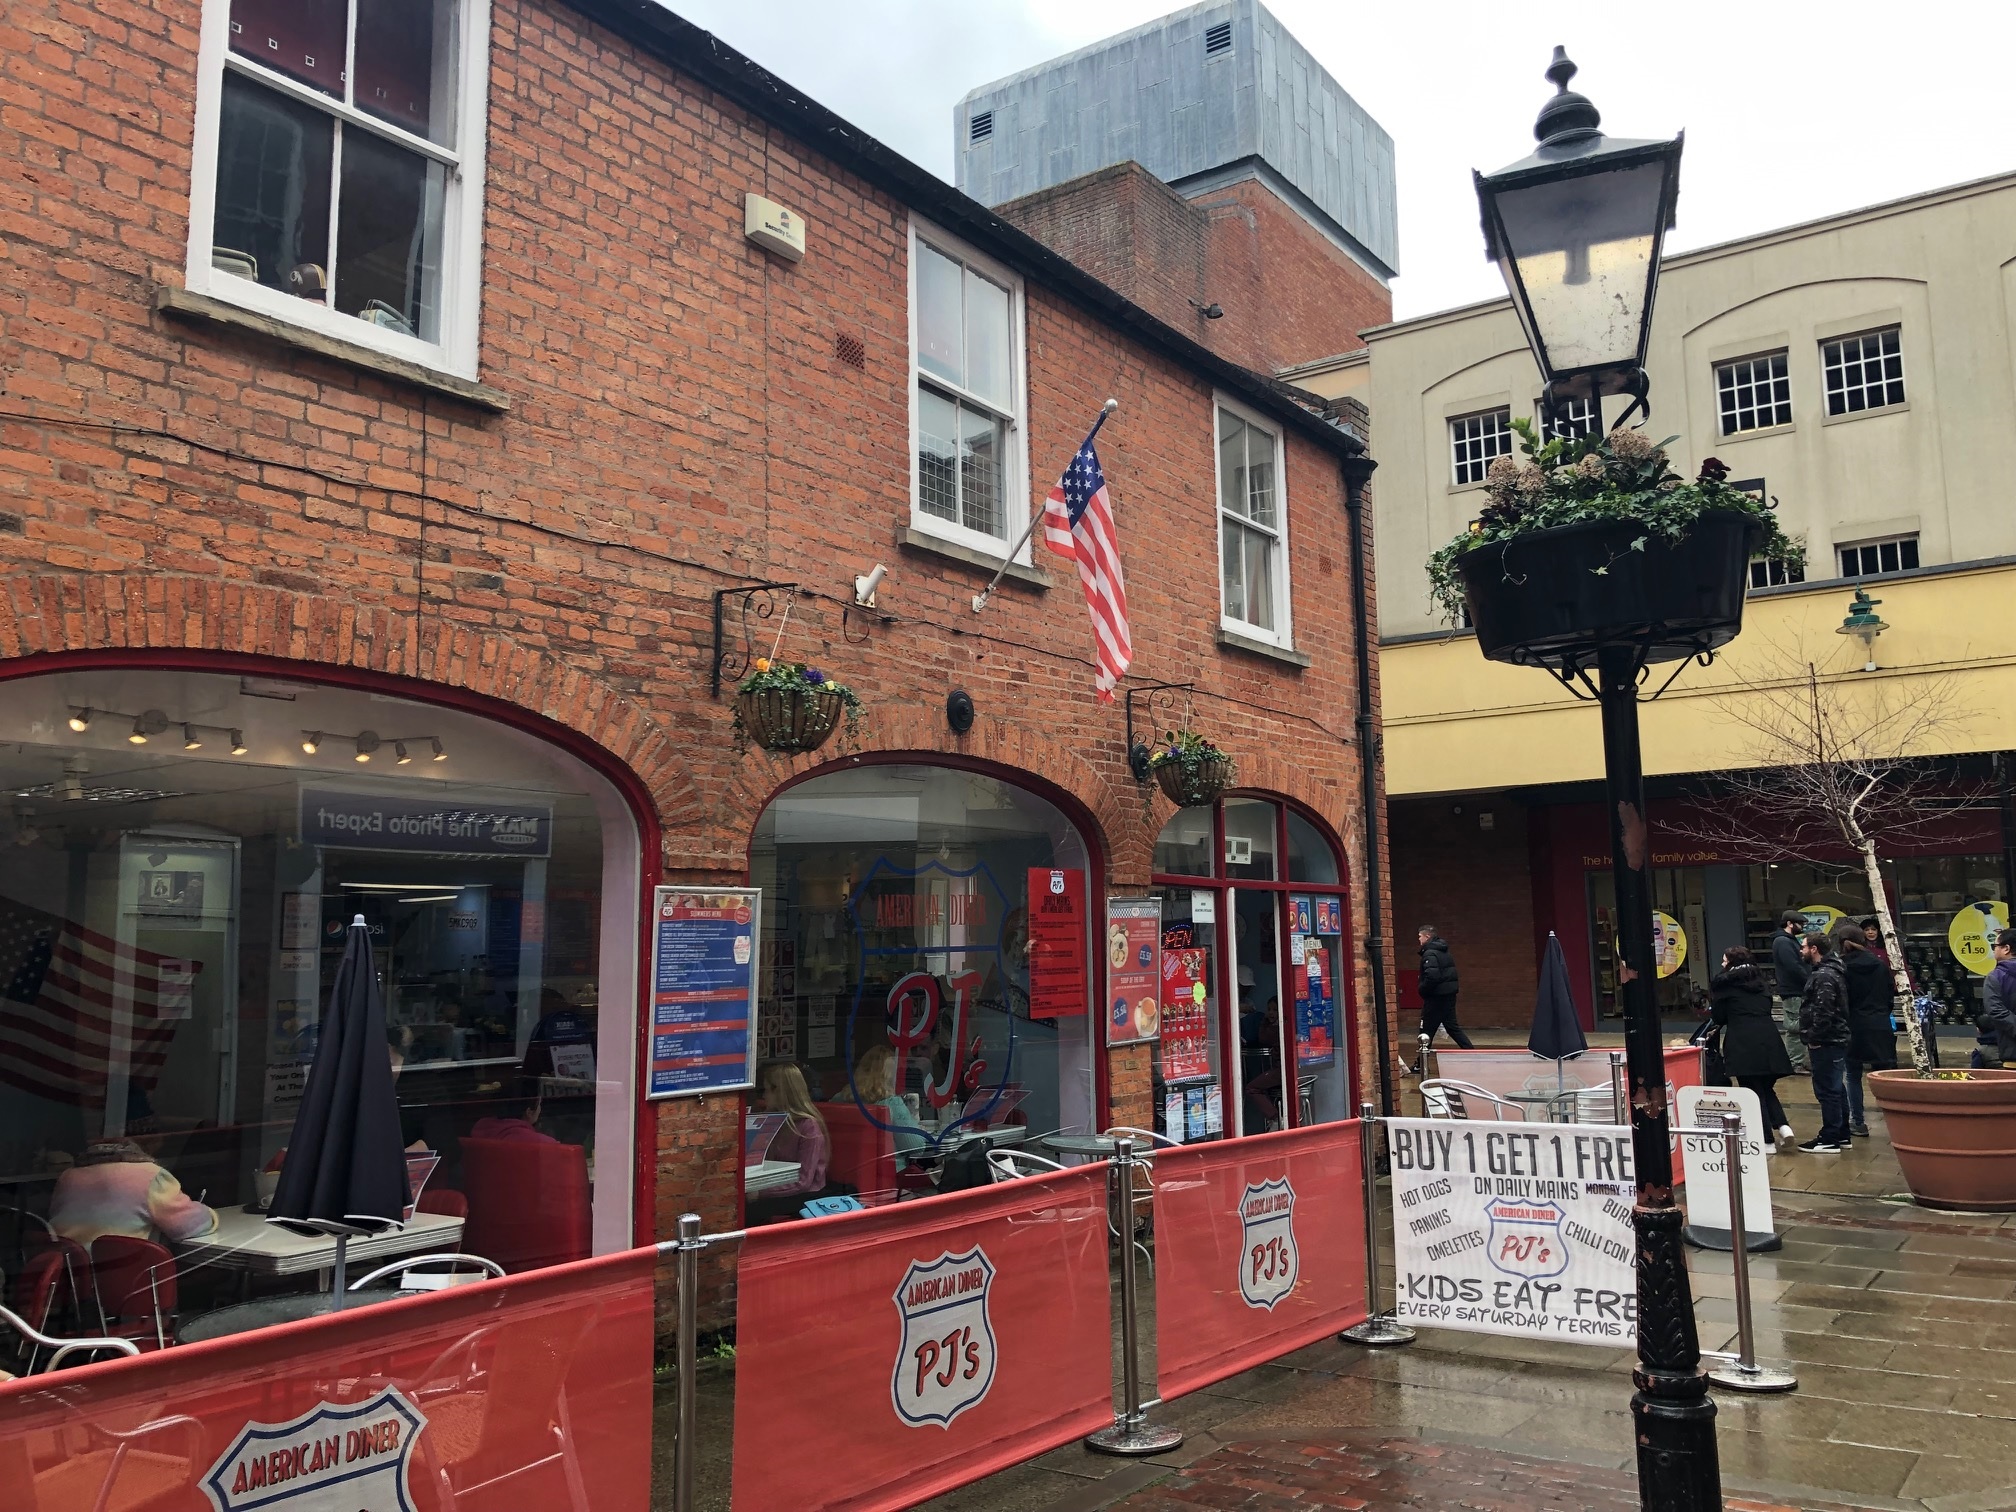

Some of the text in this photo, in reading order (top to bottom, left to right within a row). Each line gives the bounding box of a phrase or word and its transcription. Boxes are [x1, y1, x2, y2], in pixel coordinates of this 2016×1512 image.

[1582, 856, 1601, 866] The
[1652, 853, 1684, 864] family
[877, 894, 939, 927] AMERICAN
[1961, 942, 1985, 954] £1.50
[887, 968, 987, 1109] PJ's
[1394, 1129, 1634, 1182] BUY 1 GET 1 FRE
[1686, 1137, 1760, 1156] STOES
[1702, 1158, 1749, 1174] cofe
[1400, 1178, 1452, 1208] HOT DOGS
[1474, 1177, 1492, 1194] ON
[1496, 1178, 1531, 1199] DAILY
[1536, 1180, 1578, 1200] MAINS
[1585, 1182, 1620, 1195] MONDAY
[1246, 1192, 1289, 1218] AMERICAN DINER
[1493, 1206, 1556, 1221] AMERICAN DINER
[1409, 1208, 1451, 1237] PANINIS
[1426, 1230, 1484, 1262] OMELETTES
[1500, 1234, 1551, 1263] PJ's
[1565, 1220, 1603, 1250] CHILLI
[1603, 1238, 1630, 1264] CON
[1251, 1235, 1289, 1286] PJ's
[907, 1267, 984, 1307] AMERICAN DINER
[1407, 1273, 1637, 1322] KIDS EAT FRE
[1398, 1302, 1451, 1321] EVERY
[1456, 1307, 1548, 1331] SATURDAY
[1554, 1315, 1622, 1336] TERMS
[914, 1326, 980, 1397] PJ's
[231, 1419, 401, 1495] AMERICAN DINER
